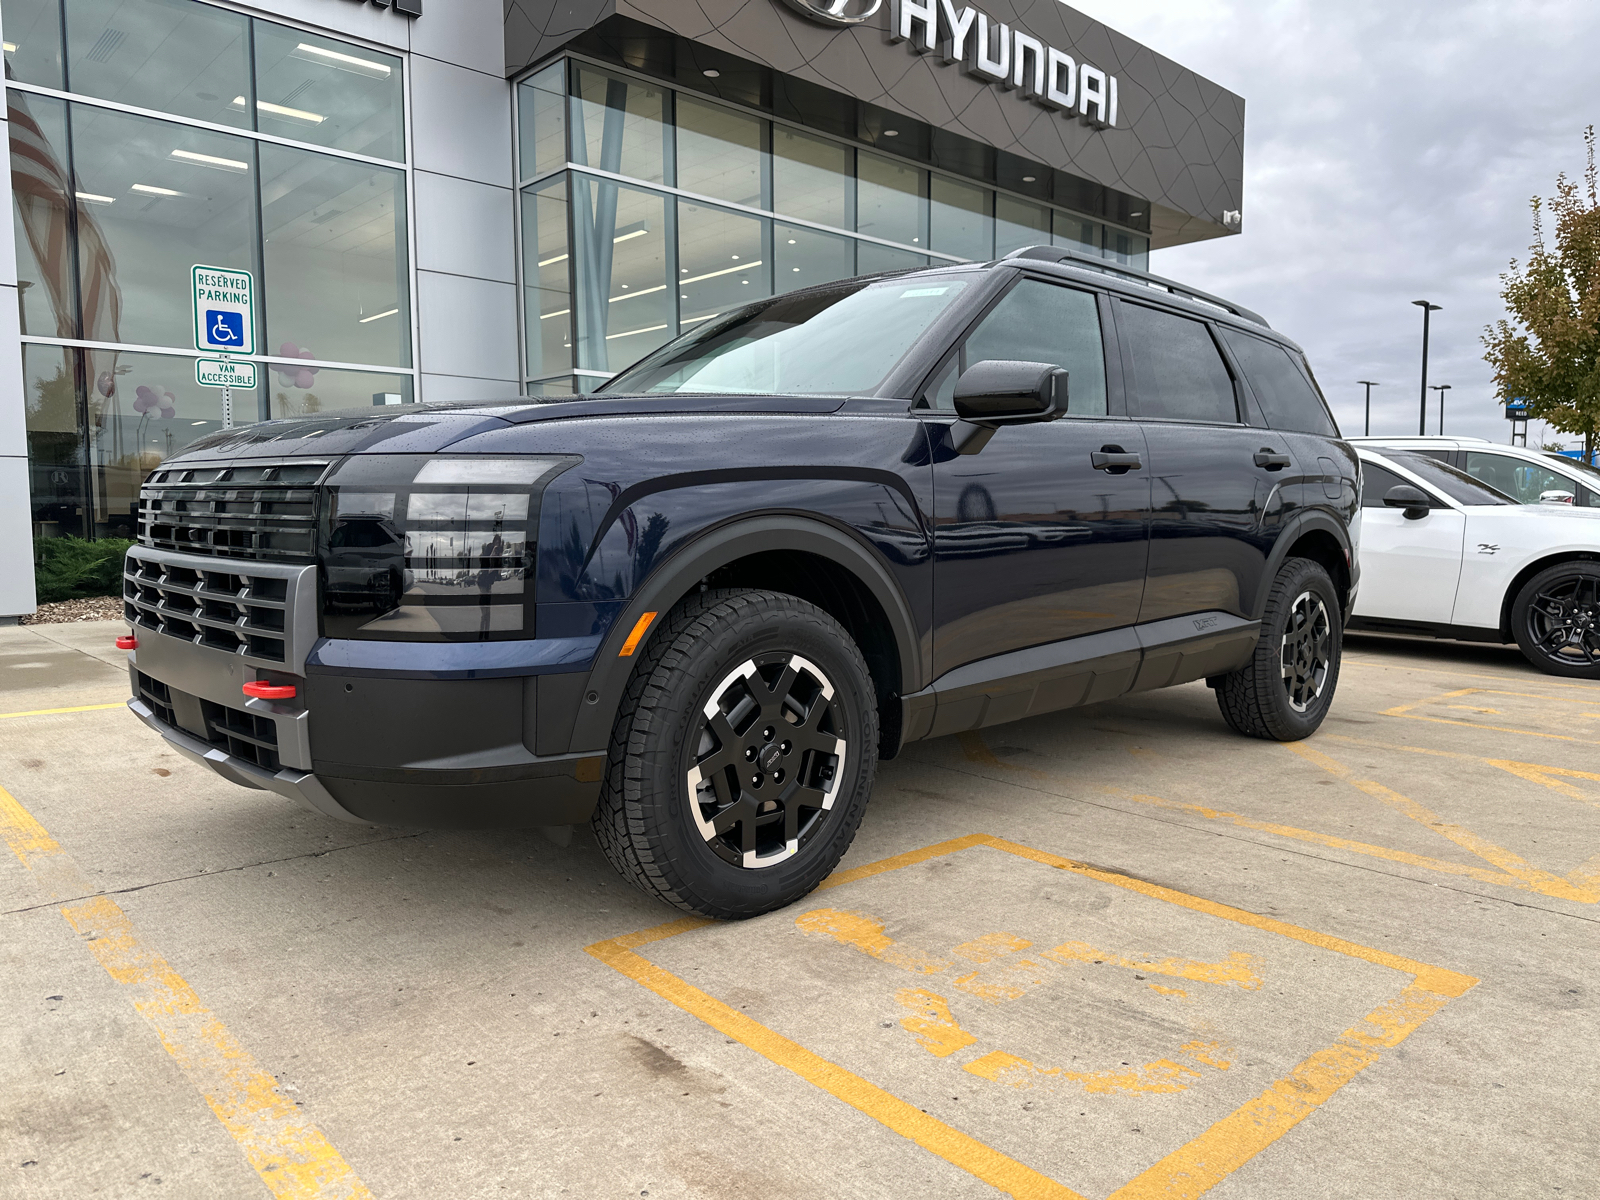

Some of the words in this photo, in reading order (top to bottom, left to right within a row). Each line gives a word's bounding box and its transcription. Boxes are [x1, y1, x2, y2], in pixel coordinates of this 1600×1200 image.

[891, 0, 1118, 129] HYUNDAI
[198, 273, 247, 290] RESERVED
[199, 289, 248, 304] PARKING
[219, 364, 235, 373] VAN
[201, 373, 252, 384] ACCESSIBLE
[831, 709, 872, 850] CONTINENTAL
